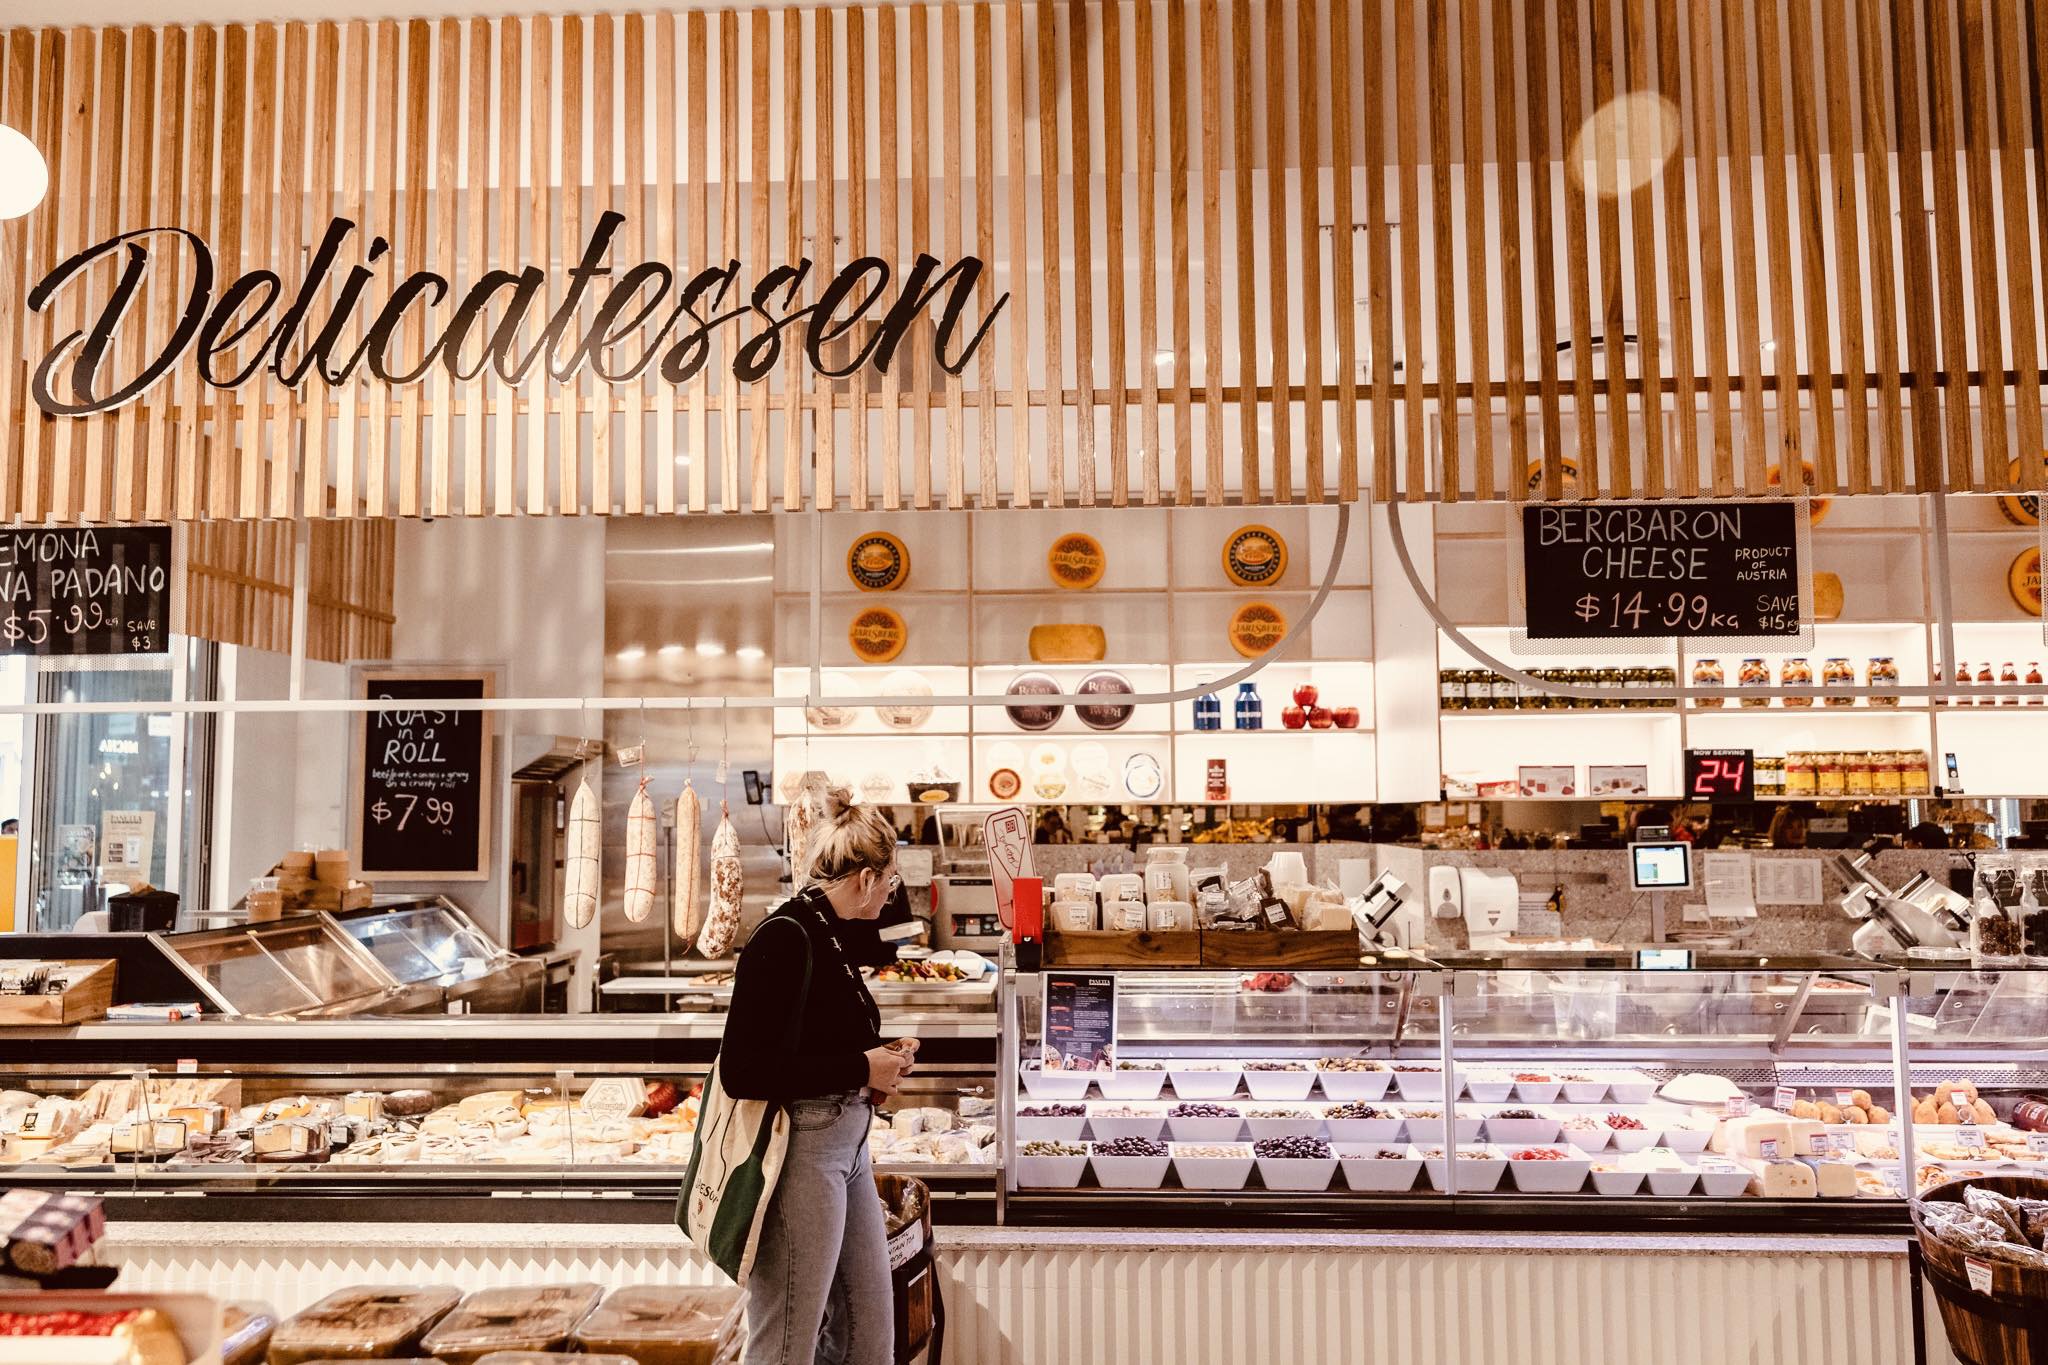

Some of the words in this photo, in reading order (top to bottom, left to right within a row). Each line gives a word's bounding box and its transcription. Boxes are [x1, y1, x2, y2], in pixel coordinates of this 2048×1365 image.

[28, 210, 1010, 417] Delicatessen
[1539, 508, 1741, 546] BERGBARON
[1582, 547, 1708, 580] CHEESE
[1735, 547, 1792, 560] PRODUCT
[1736, 569, 1787, 581] AUSTRIA
[1752, 562, 1767, 570] OF
[51, 564, 165, 600] PADANO
[1757, 595, 1798, 611] SAVE
[127, 619, 156, 632] SAVE
[132, 635, 151, 651] $3
[398, 729, 413, 740] in
[423, 728, 435, 740] a
[383, 739, 446, 764] ROLL
[1695, 760, 1744, 792] 24
[371, 794, 453, 831] $7.99
